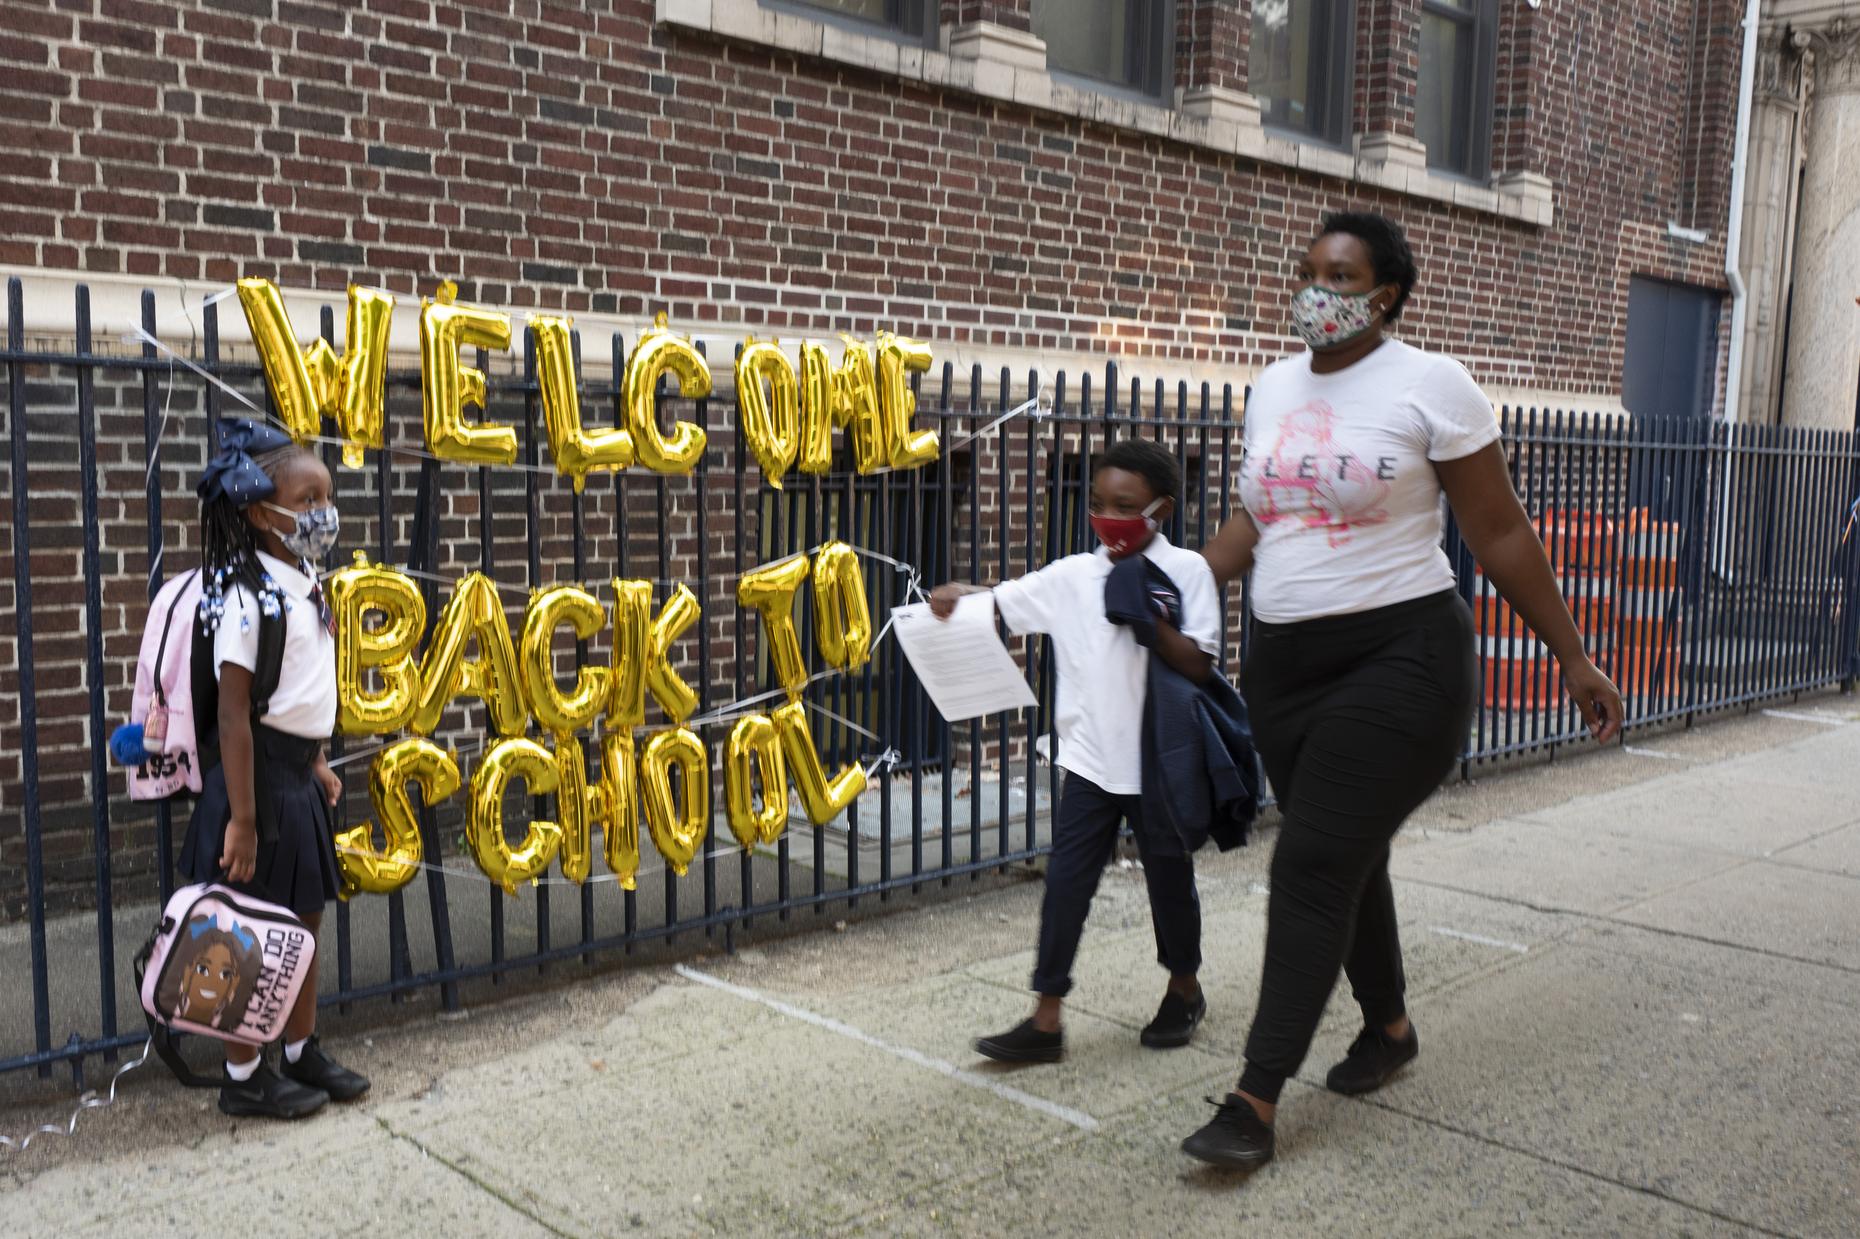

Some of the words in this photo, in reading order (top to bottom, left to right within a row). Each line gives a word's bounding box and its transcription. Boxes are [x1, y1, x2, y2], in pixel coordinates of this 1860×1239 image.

[236, 278, 940, 490] WELCOME
[328, 551, 703, 736] BACK
[737, 539, 873, 702] TO
[334, 698, 868, 897] SCHOOL
[246, 966, 277, 1014] CAN
[263, 928, 286, 958] DO
[255, 931, 305, 1035] ANYTHING
